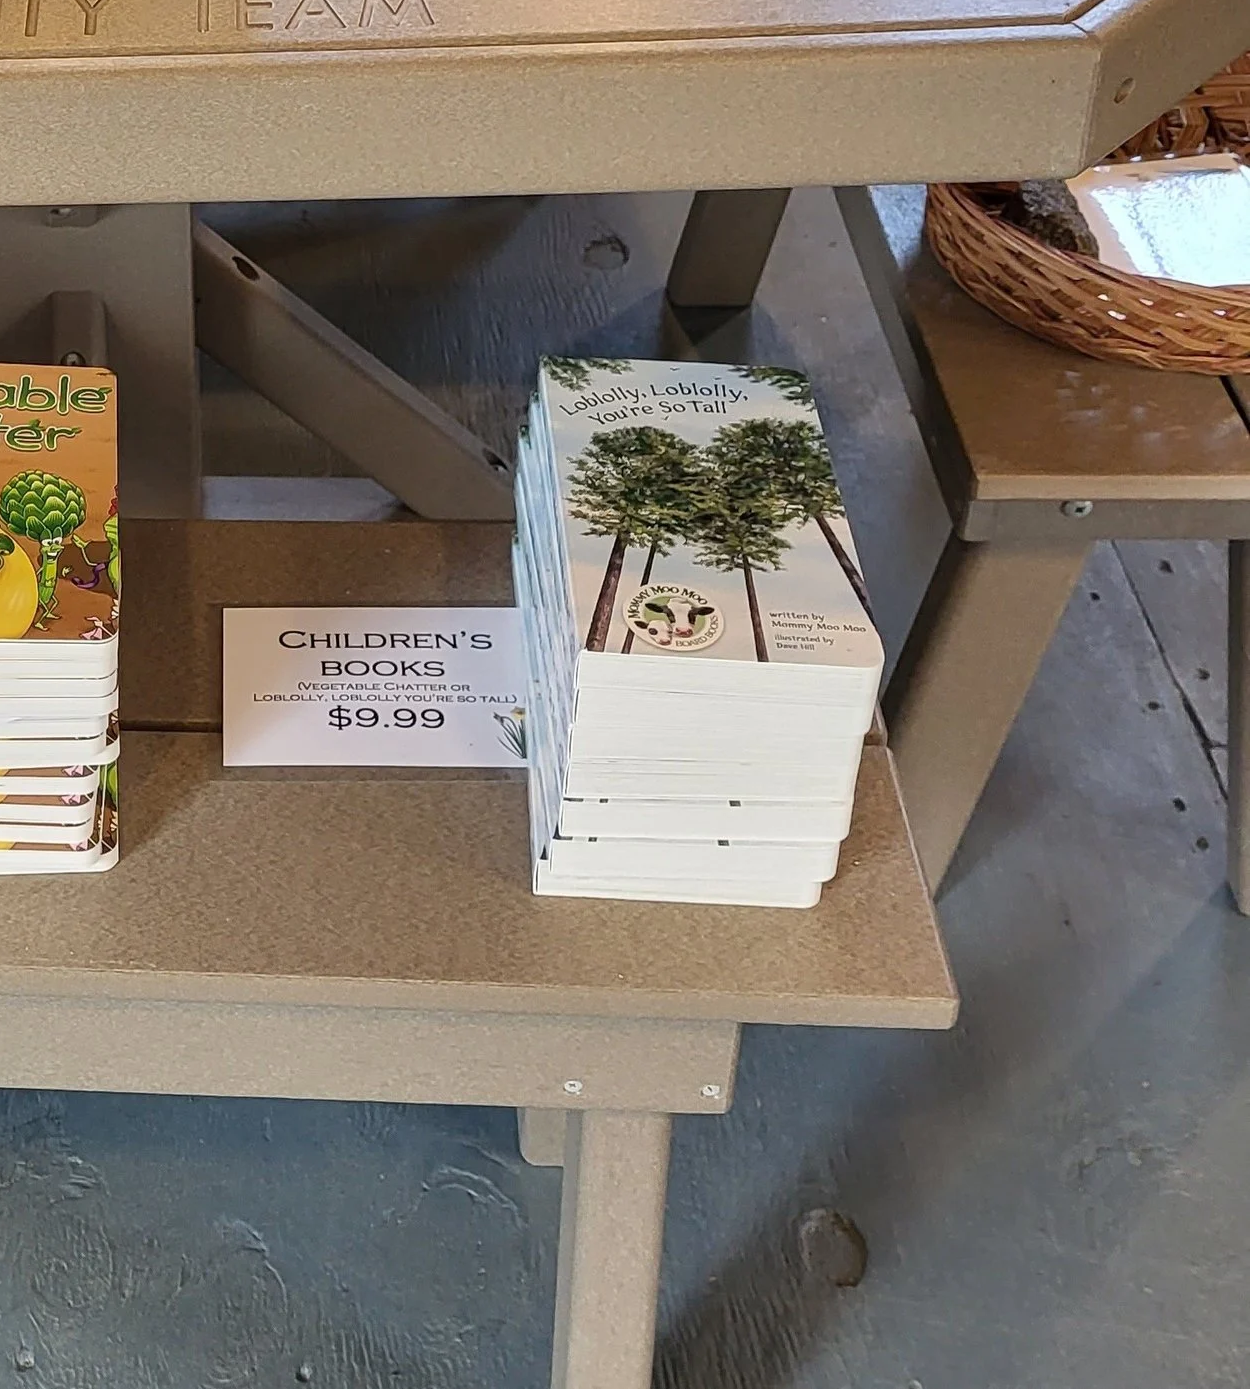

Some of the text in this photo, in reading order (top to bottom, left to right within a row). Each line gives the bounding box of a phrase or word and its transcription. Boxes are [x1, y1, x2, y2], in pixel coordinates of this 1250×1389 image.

[559, 382, 749, 418] Loblolly, Loblolly,
[587, 399, 727, 426] You're So Tall
[628, 585, 709, 619] MOMMY MOO MOO
[769, 612, 825, 623] written by
[771, 621, 867, 633] Mommy Moo Moo
[278, 630, 494, 650] CHILDREN'S
[675, 636, 707, 647] BOARD
[774, 634, 835, 645] illustrated by
[320, 660, 446, 677] BOOKS
[297, 681, 471, 693] (VEGETABLE CHATTER OR
[253, 693, 518, 705] LOBLOLLY, LOBLOLLY YOU'RE SO TALL)
[328, 705, 446, 731] $9.99
